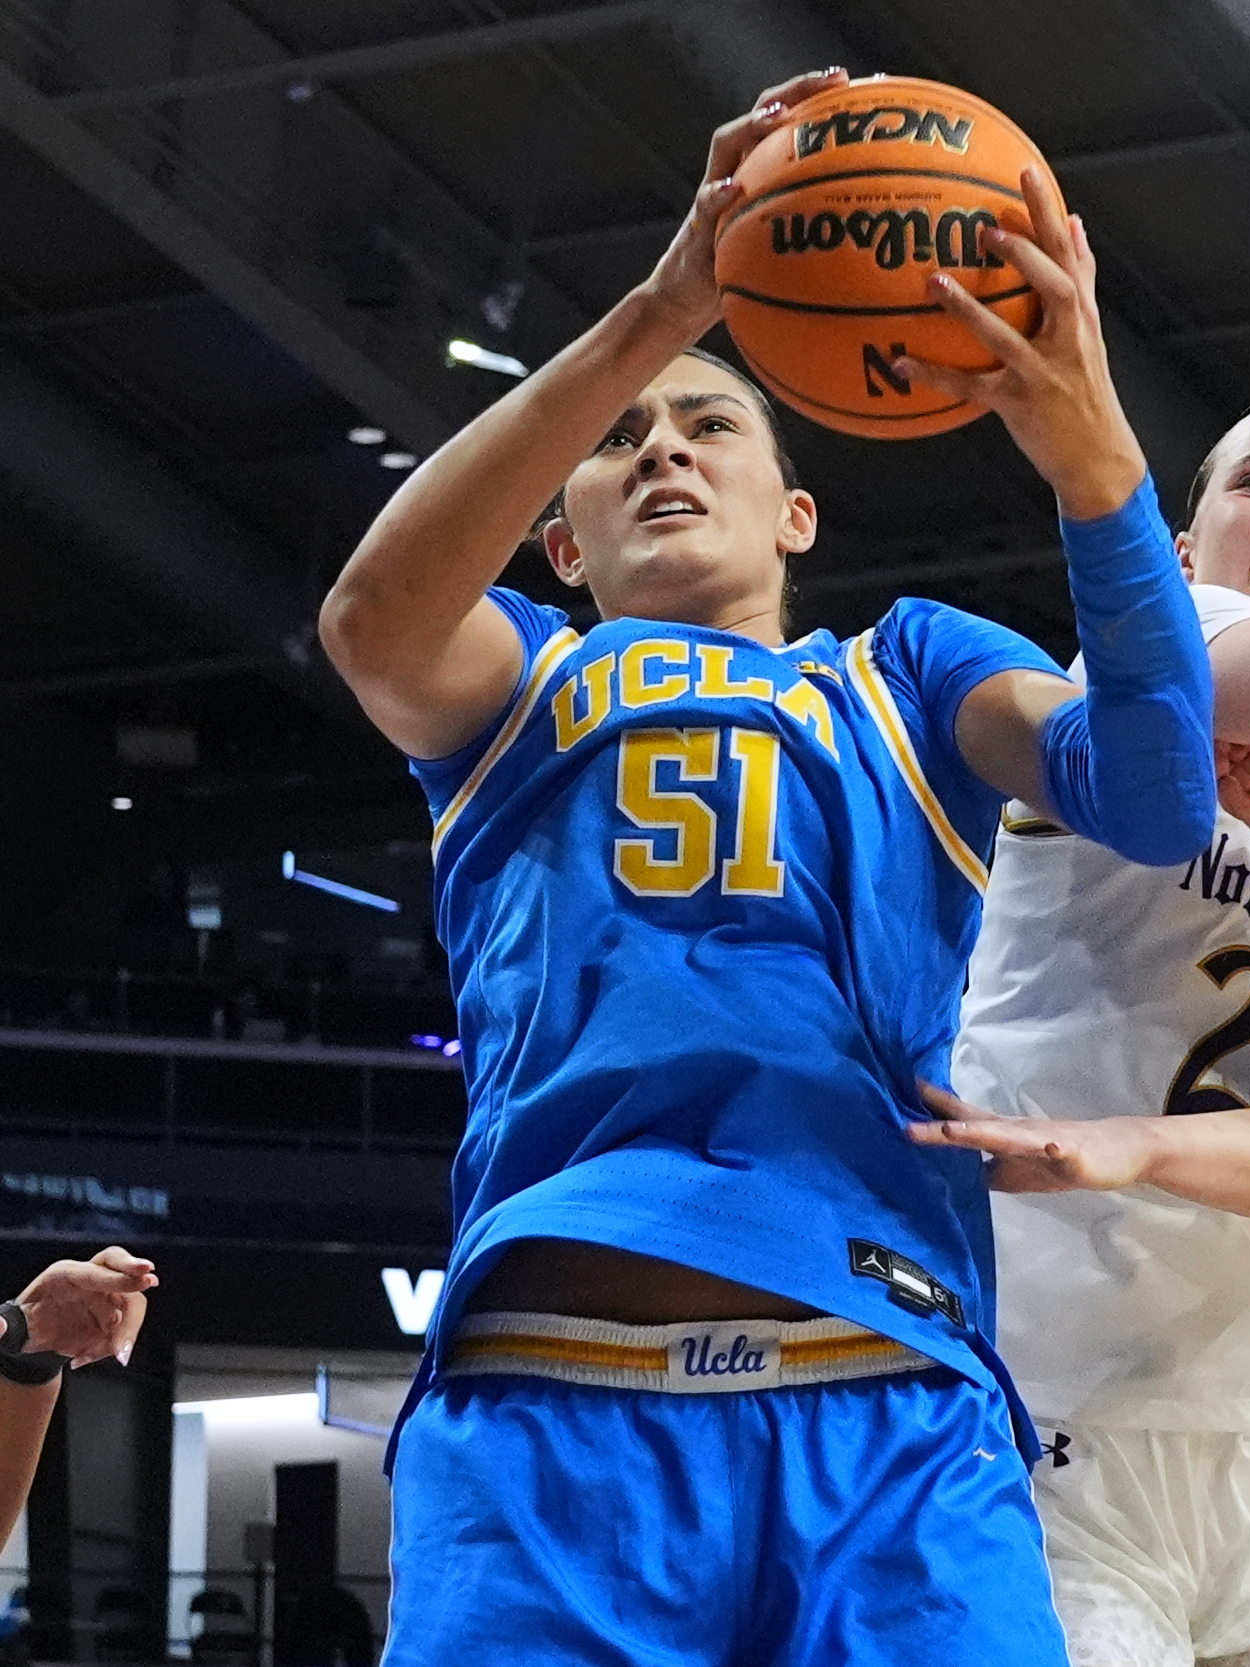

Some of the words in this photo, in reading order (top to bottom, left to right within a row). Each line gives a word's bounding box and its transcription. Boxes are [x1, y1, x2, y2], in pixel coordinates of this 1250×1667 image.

[793, 105, 975, 158] NCAA
[768, 206, 1005, 270] Wilson
[552, 638, 841, 764] UCLA
[613, 726, 785, 898] 51
[681, 1334, 767, 1376] Ucla
